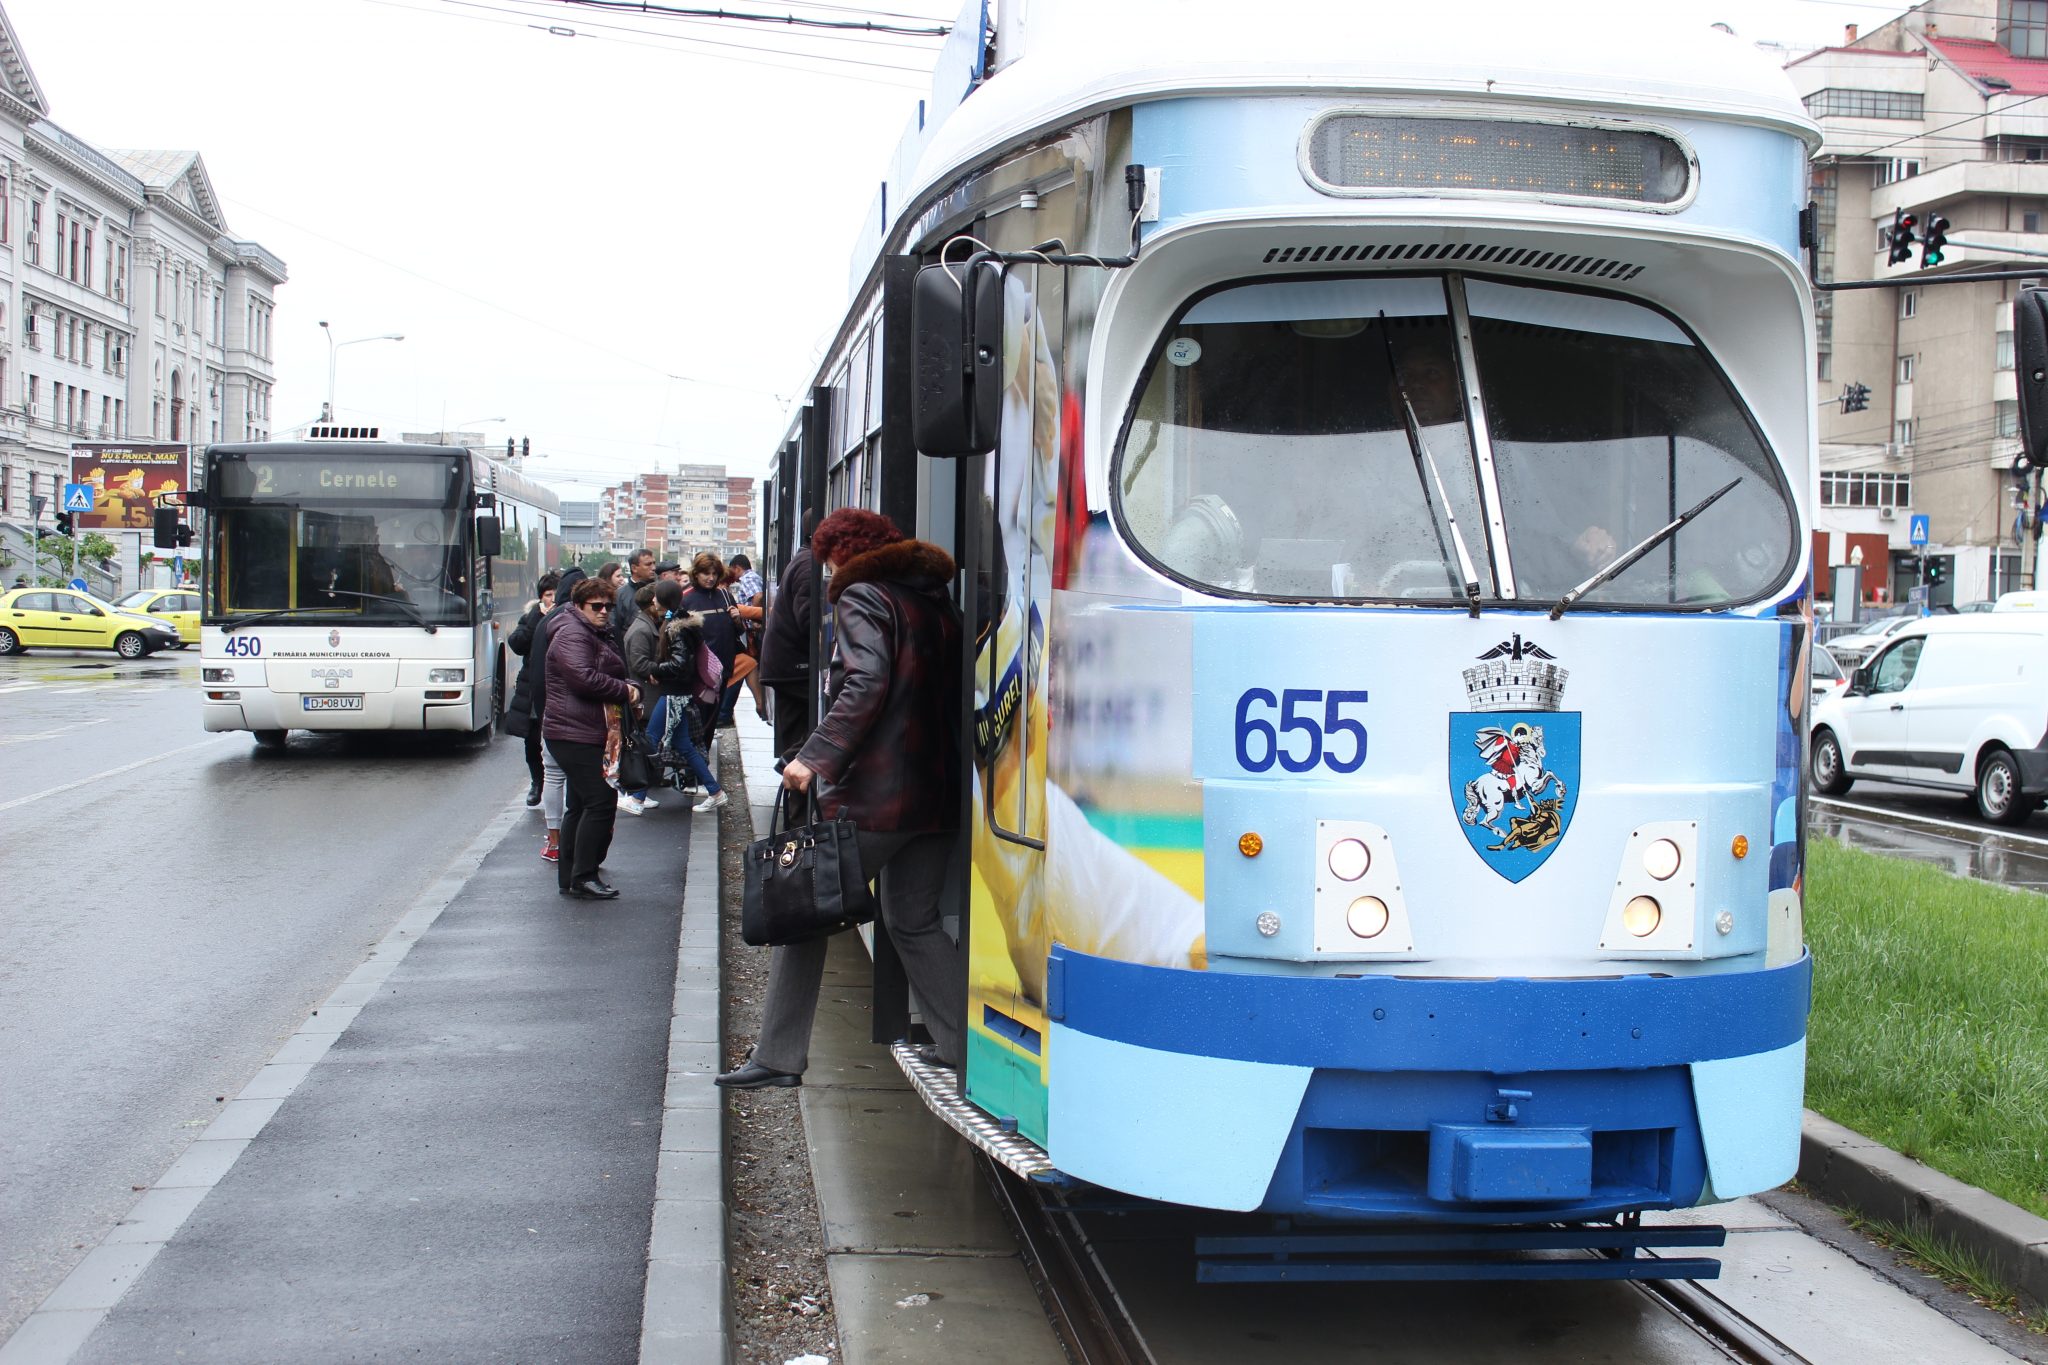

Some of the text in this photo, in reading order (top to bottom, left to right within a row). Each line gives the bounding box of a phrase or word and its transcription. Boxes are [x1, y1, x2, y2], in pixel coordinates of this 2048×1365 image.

[257, 464, 398, 493] 2 Cernele
[224, 636, 262, 657] 450
[311, 668, 354, 678] MAN
[1235, 687, 1369, 774] 655
